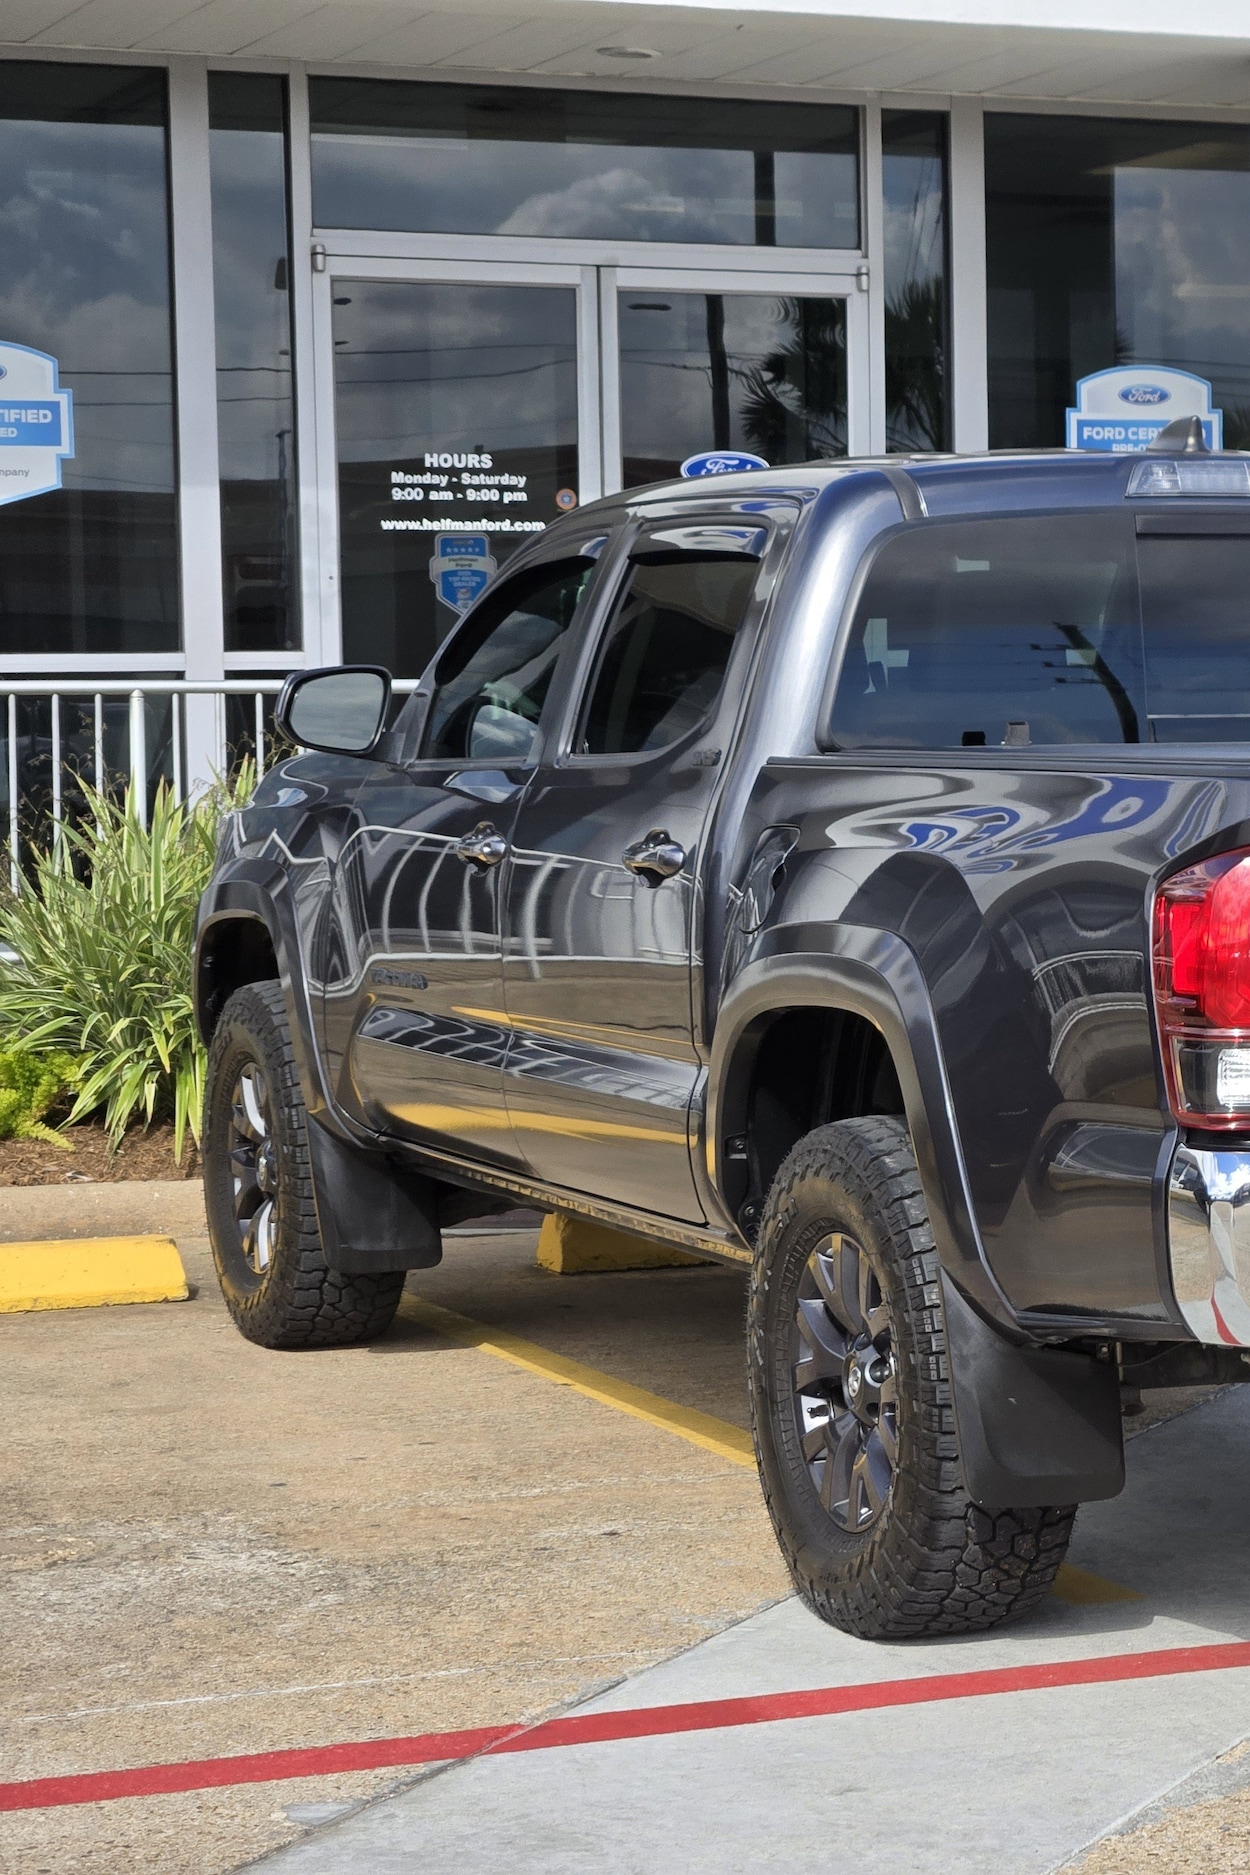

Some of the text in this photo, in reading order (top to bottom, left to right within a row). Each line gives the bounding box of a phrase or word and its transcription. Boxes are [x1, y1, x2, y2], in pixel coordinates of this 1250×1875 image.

[1128, 387, 1161, 402] Ford
[1083, 427, 1126, 440] FORD
[424, 453, 494, 468] HOURS
[391, 471, 449, 487] Monday
[461, 472, 528, 488] Saturday
[391, 488, 424, 501] 9:00
[428, 489, 454, 501] am
[466, 488, 500, 501] 9:00
[503, 490, 528, 504] pm
[380, 518, 546, 532] www.helfmanford.com
